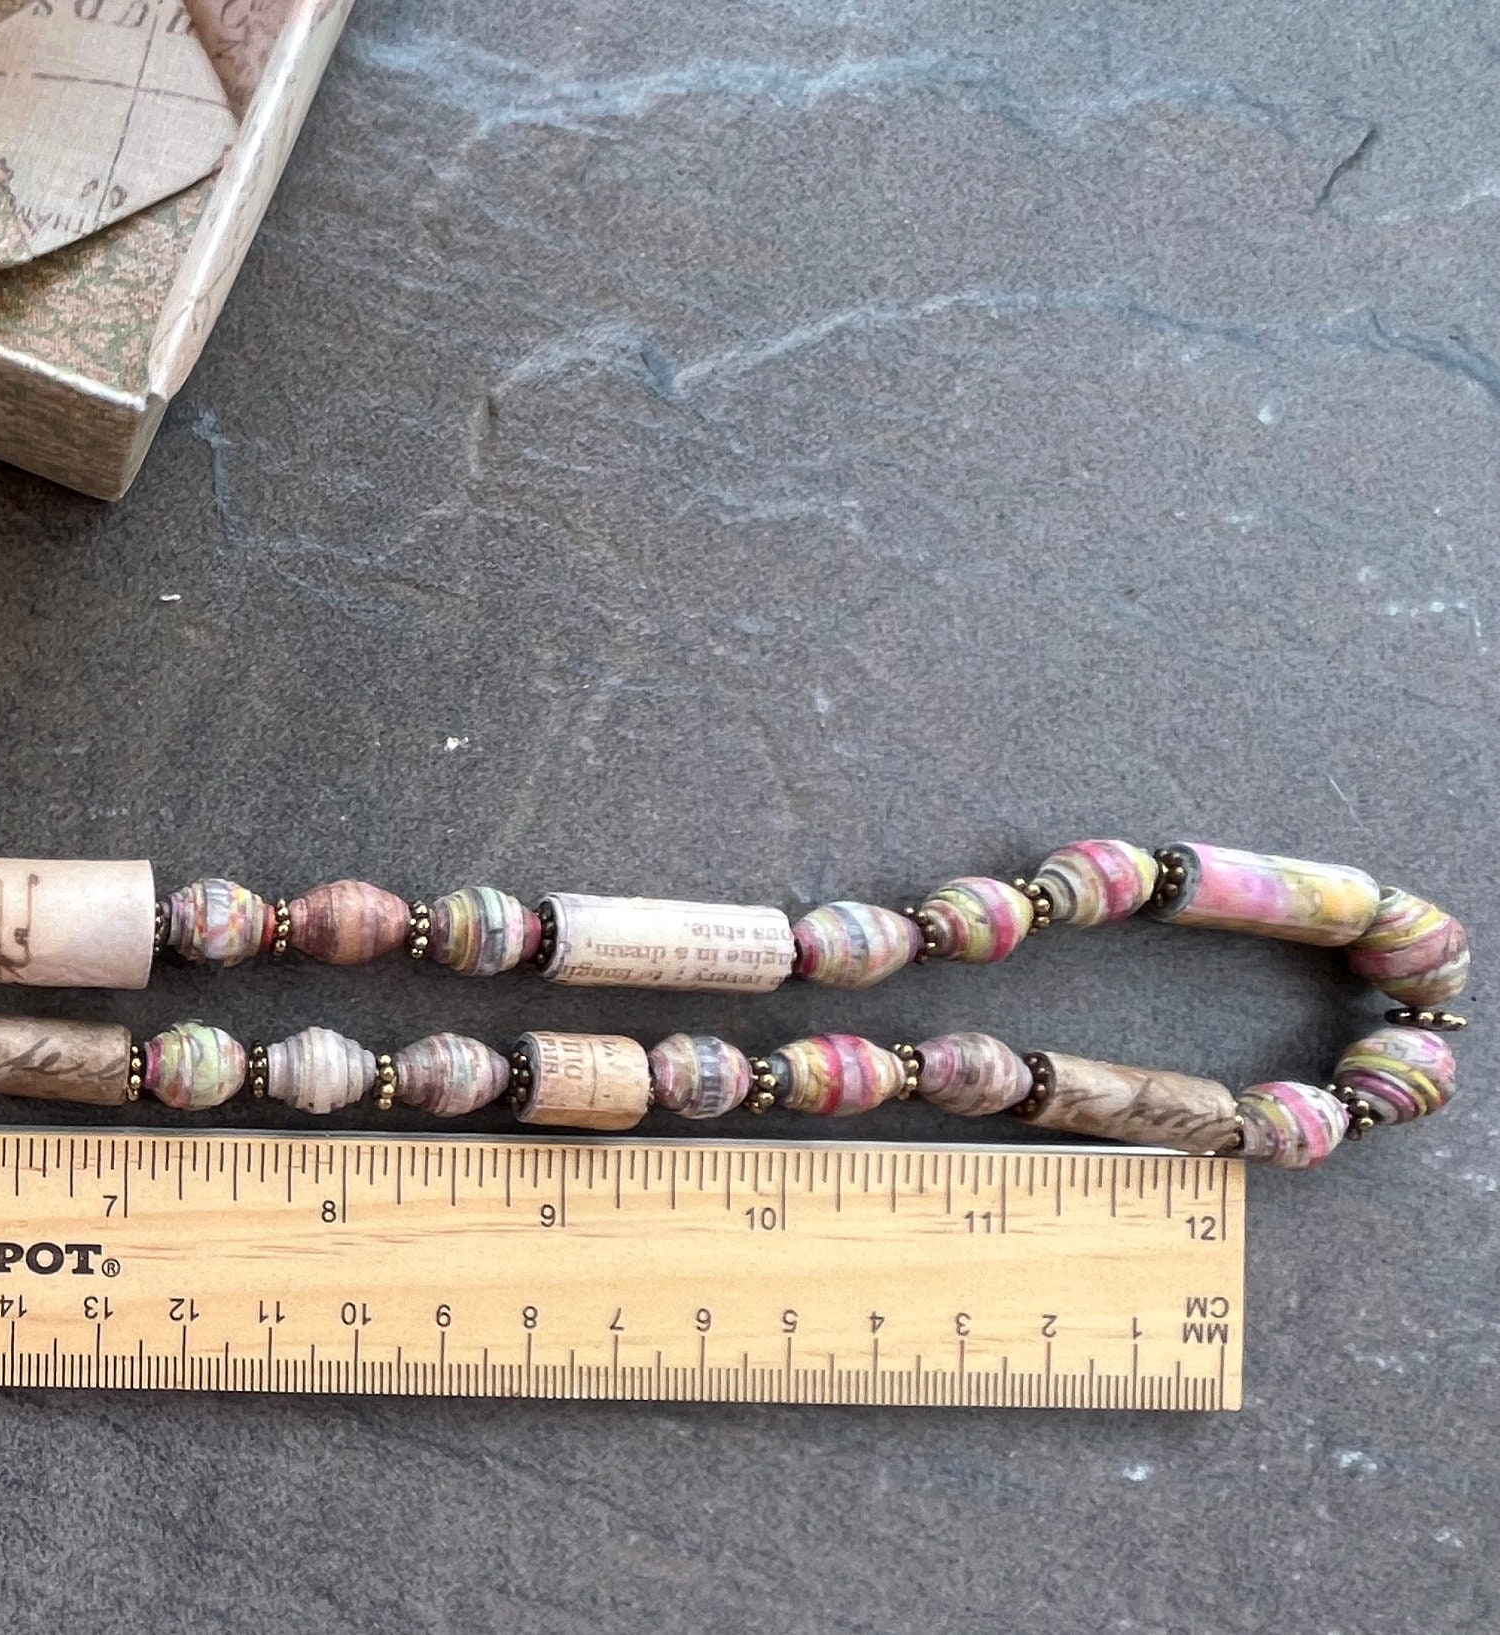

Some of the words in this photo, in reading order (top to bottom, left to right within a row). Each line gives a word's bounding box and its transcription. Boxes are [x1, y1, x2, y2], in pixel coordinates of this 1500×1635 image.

[103, 1195, 118, 1217] 7
[320, 1200, 337, 1223] 8
[539, 1204, 556, 1227] 9
[745, 1207, 777, 1231] 10
[965, 1211, 992, 1233] 11
[1186, 1217, 1215, 1240] 12
[0, 1295, 27, 1317] 14
[83, 1296, 113, 1319] 13
[169, 1298, 200, 1321] 12
[258, 1300, 284, 1322] 11
[341, 1302, 371, 1325] 10
[436, 1304, 451, 1327] 9
[523, 1305, 538, 1329] 8
[1185, 1296, 1230, 1318] CM
[609, 1308, 624, 1331] 7
[695, 1309, 711, 1332] 6
[781, 1310, 797, 1333] 5
[868, 1311, 885, 1333] 4
[955, 1312, 970, 1335] 3
[1041, 1314, 1057, 1336] 2
[1131, 1317, 1141, 1339] 1
[1183, 1323, 1229, 1344] MM
